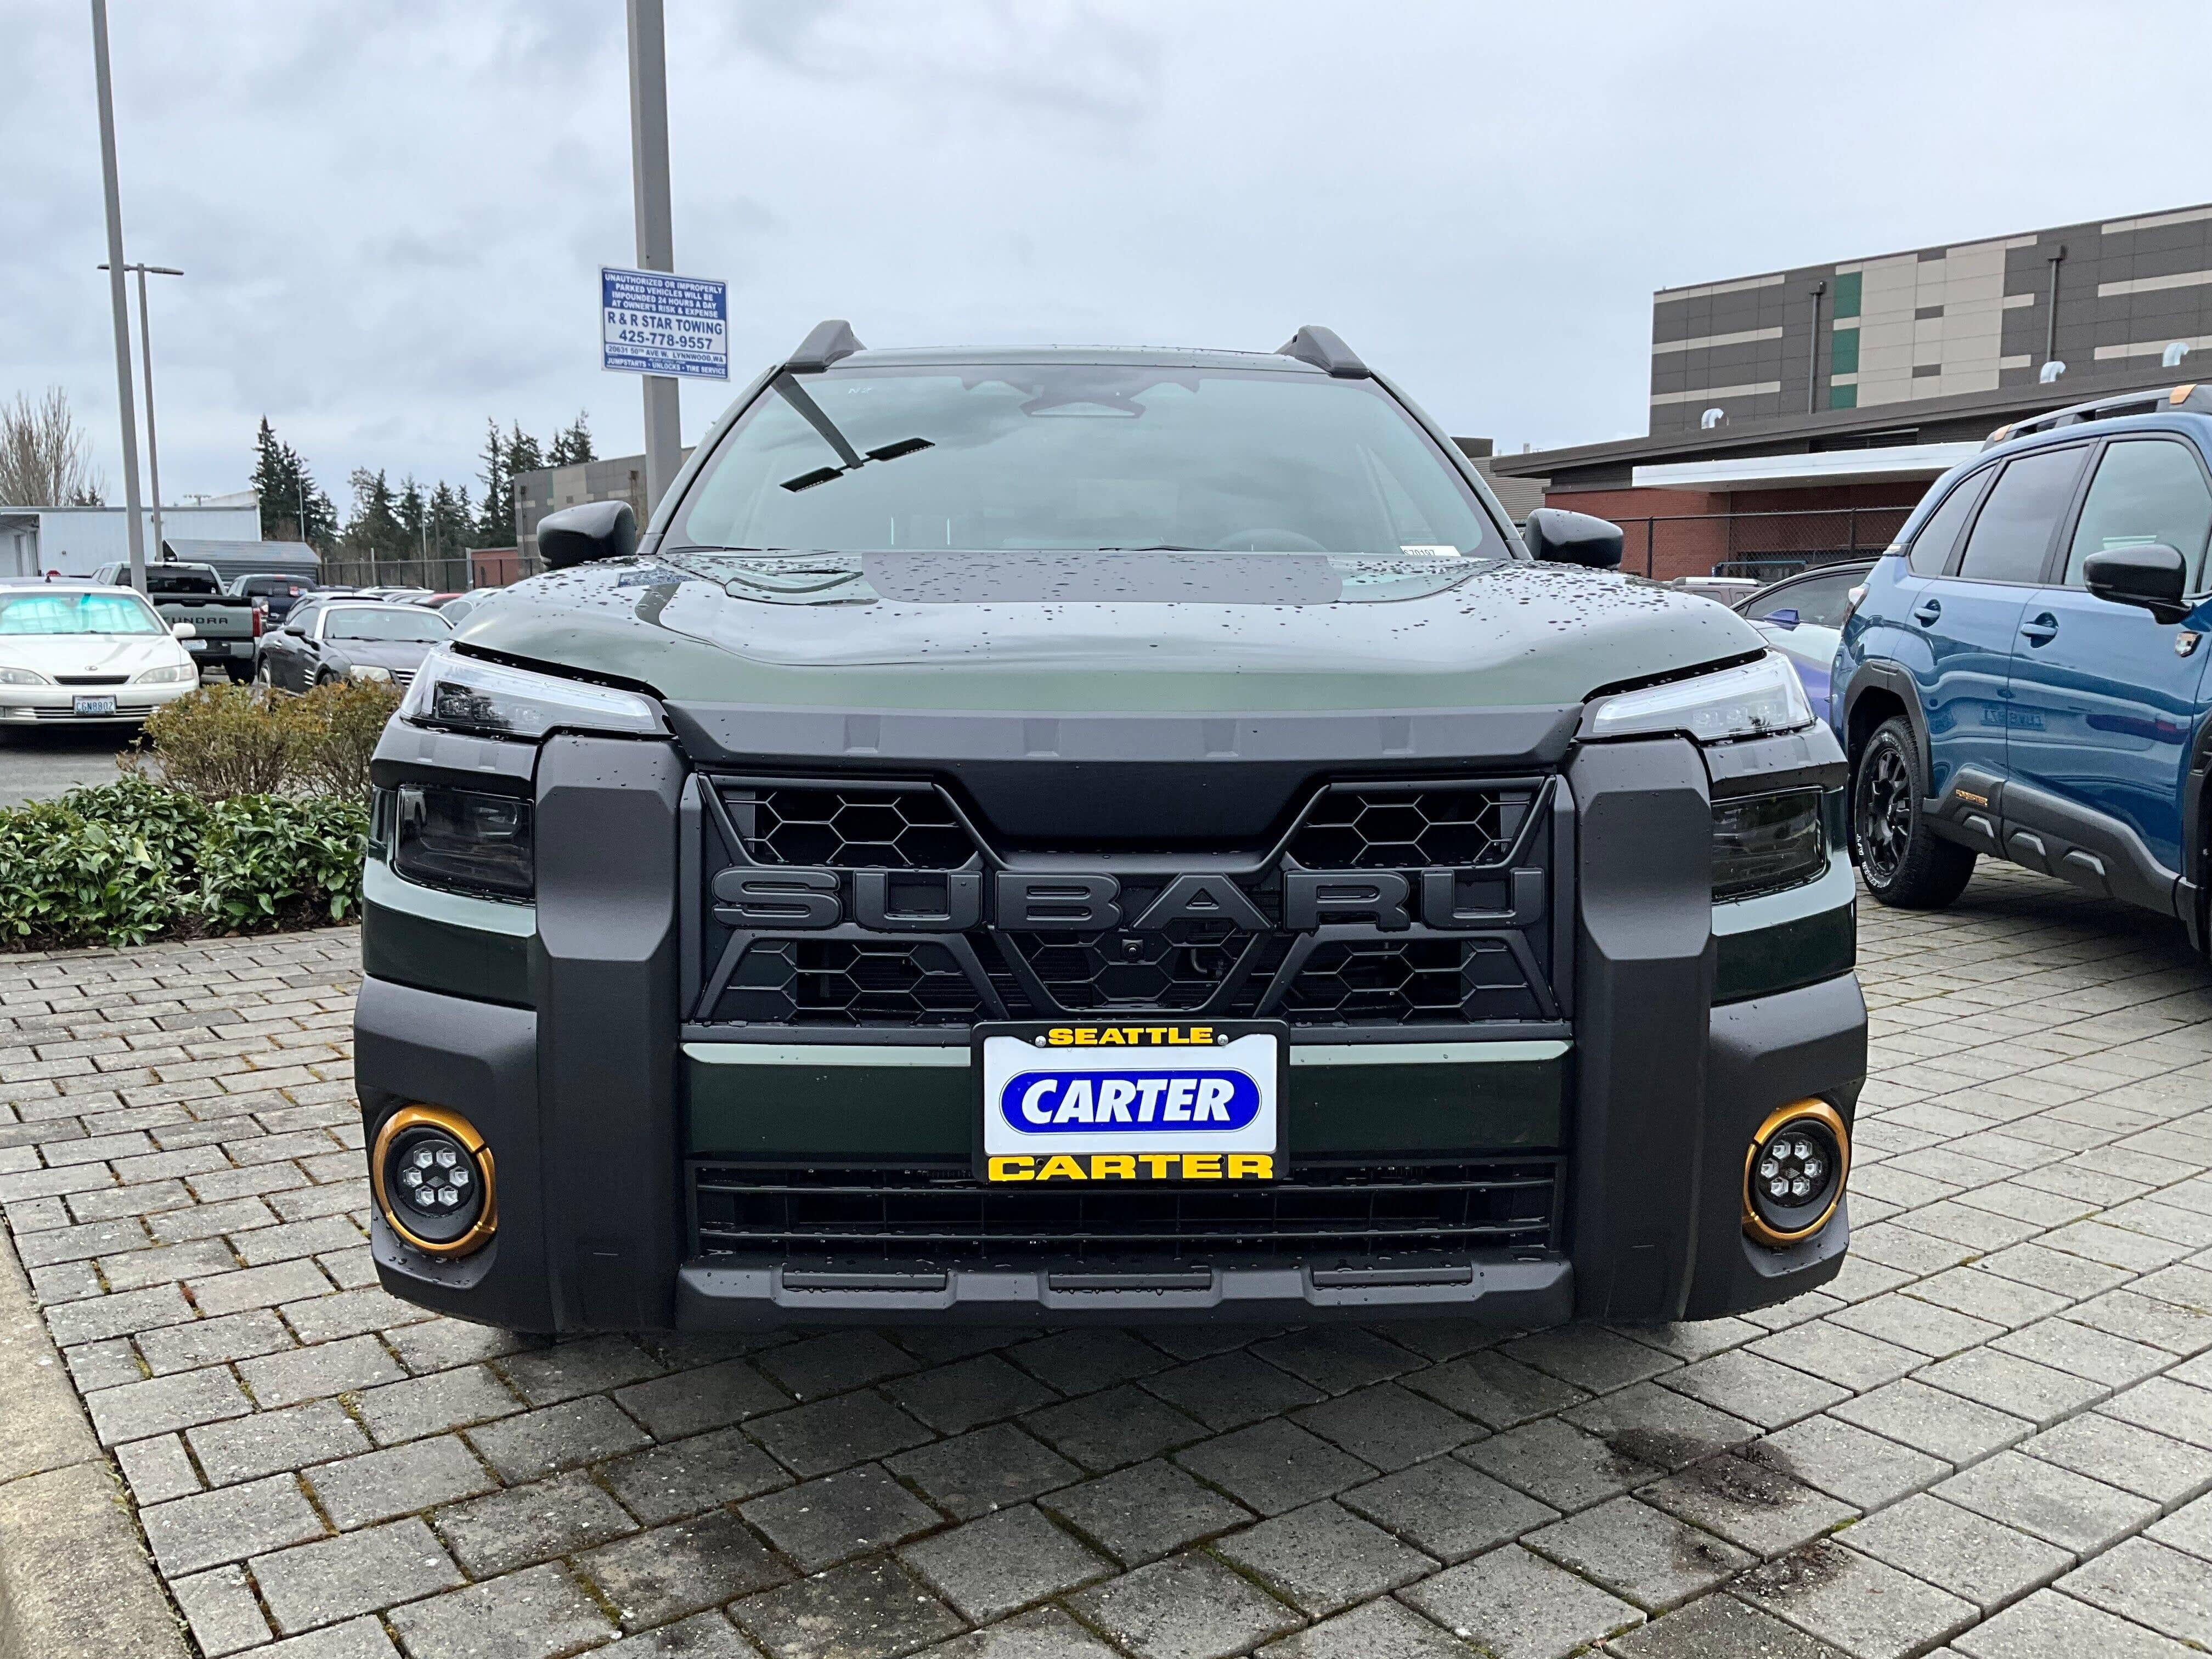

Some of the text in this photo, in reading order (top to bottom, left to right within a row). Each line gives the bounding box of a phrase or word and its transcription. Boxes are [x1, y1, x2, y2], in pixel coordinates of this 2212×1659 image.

[605, 273, 723, 294] UNAUTHORIZED OR IMPROPERLY
[616, 283, 713, 301] PARKED VEHICLES WILL BE
[612, 291, 656, 303] IMPOUNDED
[668, 298, 694, 307] HOURS
[702, 301, 717, 309] DAY
[623, 301, 656, 312] OWNER'S
[658, 304, 676, 313] RISK
[685, 308, 718, 318] EXPENSE
[608, 311, 723, 335] R & R STAR TOWING
[619, 329, 713, 349] 425-778-9557
[607, 358, 647, 368] JUMPSTARTS
[652, 362, 680, 371] UNLOCKS
[701, 366, 725, 375] SERVICE
[712, 866, 1545, 931] SUBARU
[1048, 1026, 1213, 1045] SEATTLE
[1021, 1078, 1235, 1125] CARTER
[988, 1154, 1273, 1181] CARTER
